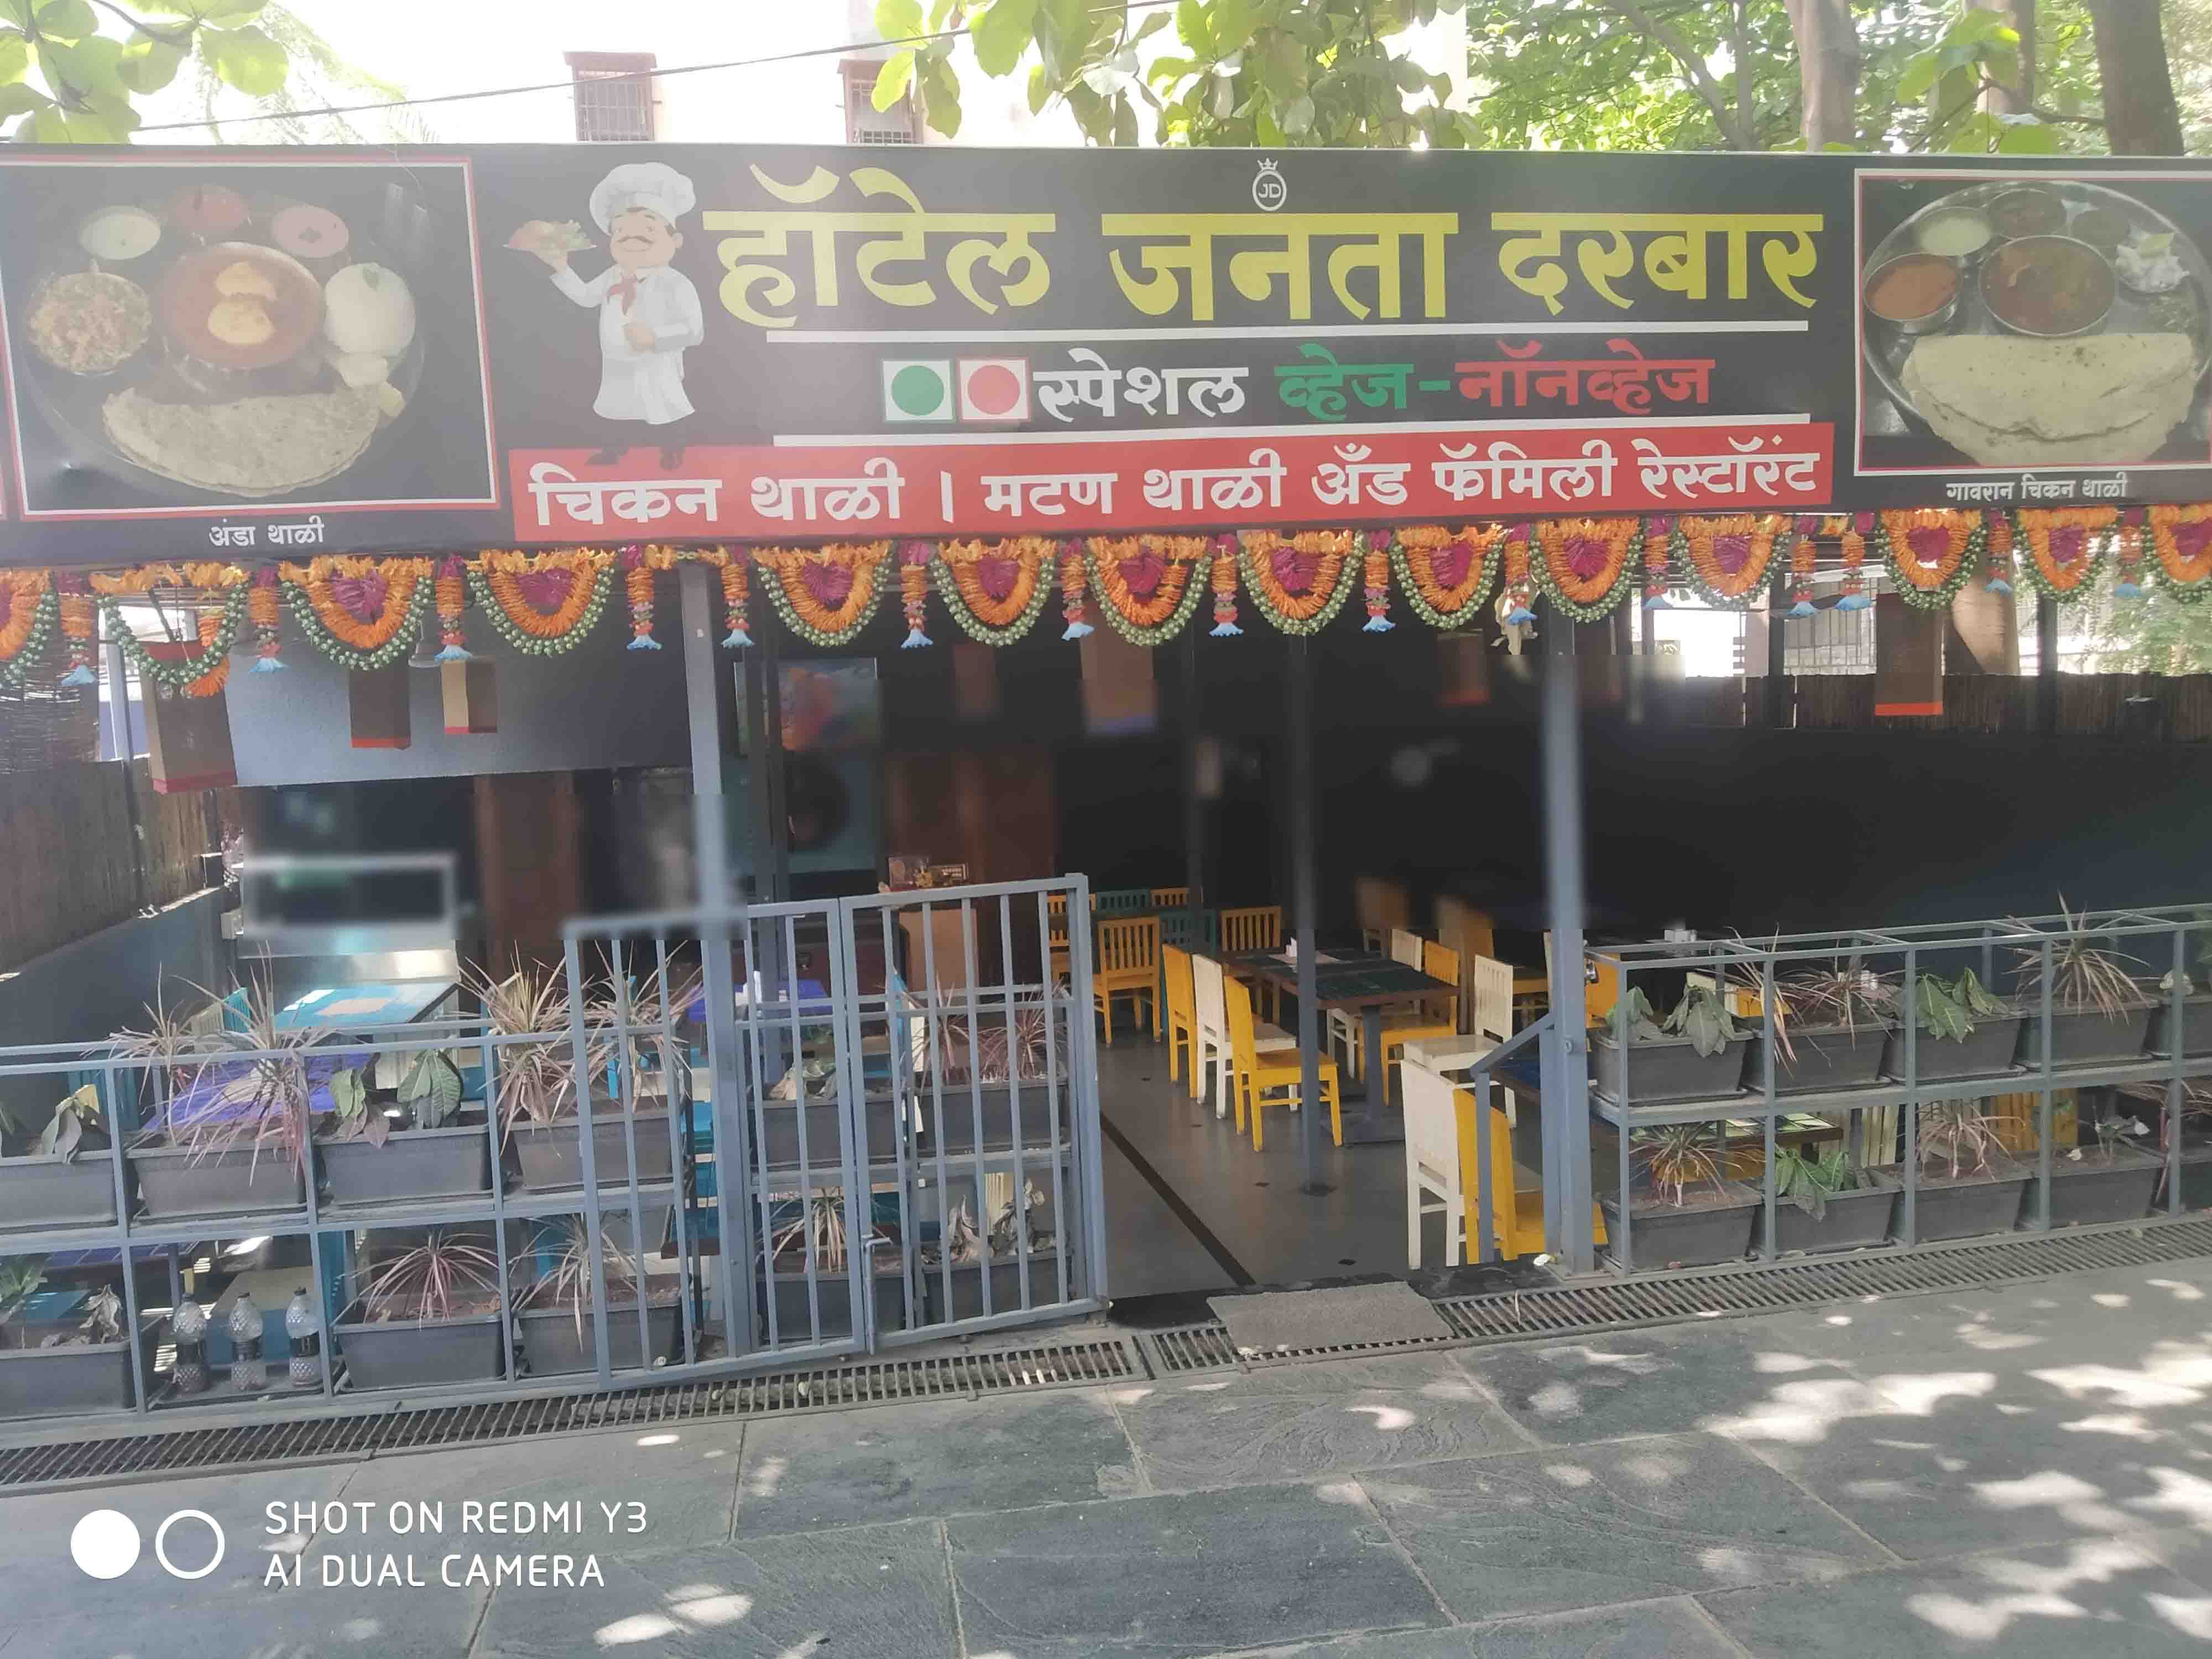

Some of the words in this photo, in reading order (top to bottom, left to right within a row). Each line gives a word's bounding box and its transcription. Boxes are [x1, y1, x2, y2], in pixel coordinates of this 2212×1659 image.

[1258, 183, 1281, 198] JD
[702, 163, 1055, 327] हॉटेल
[1102, 213, 1459, 320] जनता
[1491, 212, 1823, 315] दरबार
[1032, 347, 1249, 422] स्पेशल
[527, 462, 722, 525] चिकन
[751, 457, 905, 521] थाळी
[981, 473, 1118, 517] मटण
[1144, 448, 1287, 511] थाळी
[1431, 439, 1618, 502] फॅमिली
[1630, 436, 1820, 499] रेस्टॉरंट
[1946, 482, 2015, 501] गावरान
[2021, 473, 2076, 499] चिकन
[2082, 472, 2128, 498] थाळी
[208, 518, 256, 546] अंडा
[268, 515, 325, 544] थाळी
